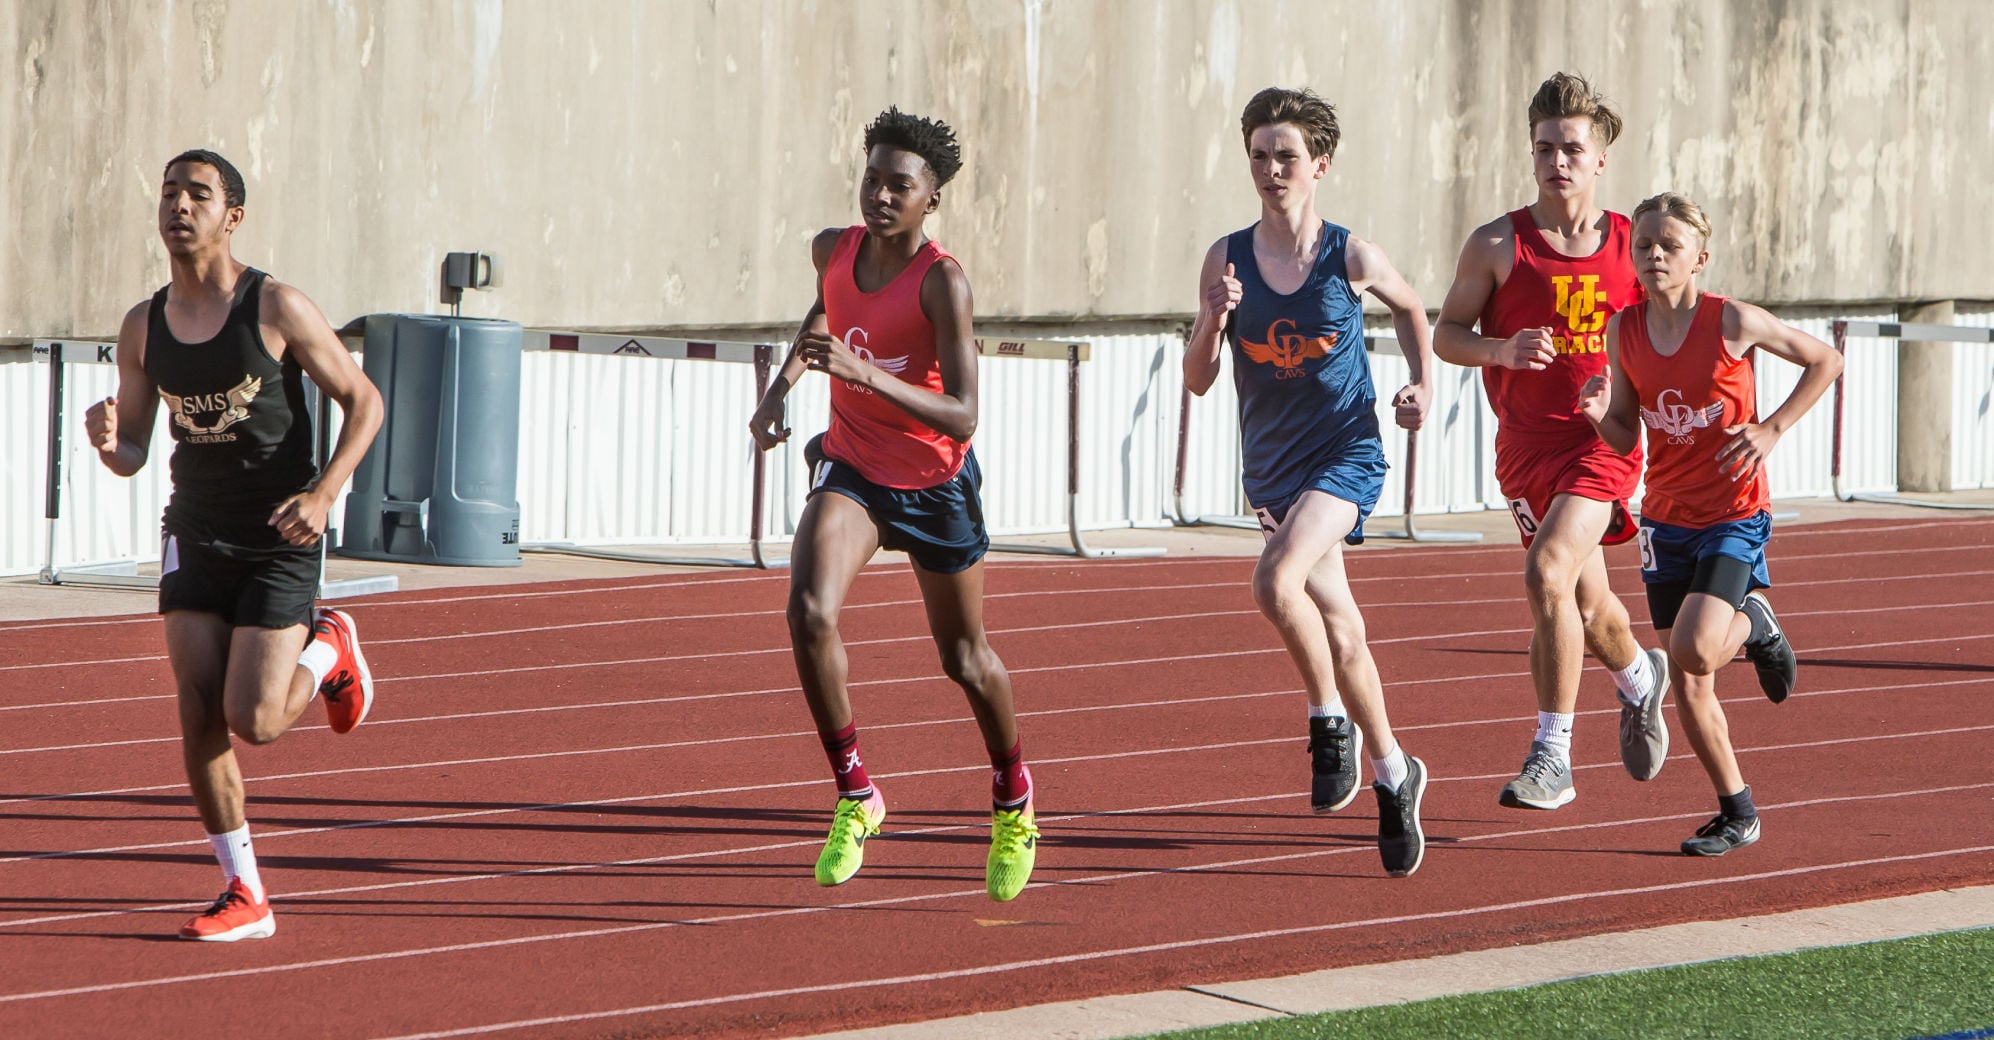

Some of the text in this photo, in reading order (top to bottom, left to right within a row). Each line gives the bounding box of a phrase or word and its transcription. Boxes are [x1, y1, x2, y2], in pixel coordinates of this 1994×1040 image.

[998, 342, 1025, 353] GILL
[1552, 334, 1607, 354] RAC
[97, 346, 112, 362] K
[1275, 368, 1306, 380] CAVS
[183, 393, 227, 414] SMS
[185, 432, 237, 444] LEOPARDS
[1667, 435, 1695, 445] CAVS
[1512, 501, 1538, 533] 6
[1642, 529, 1652, 569] 3
